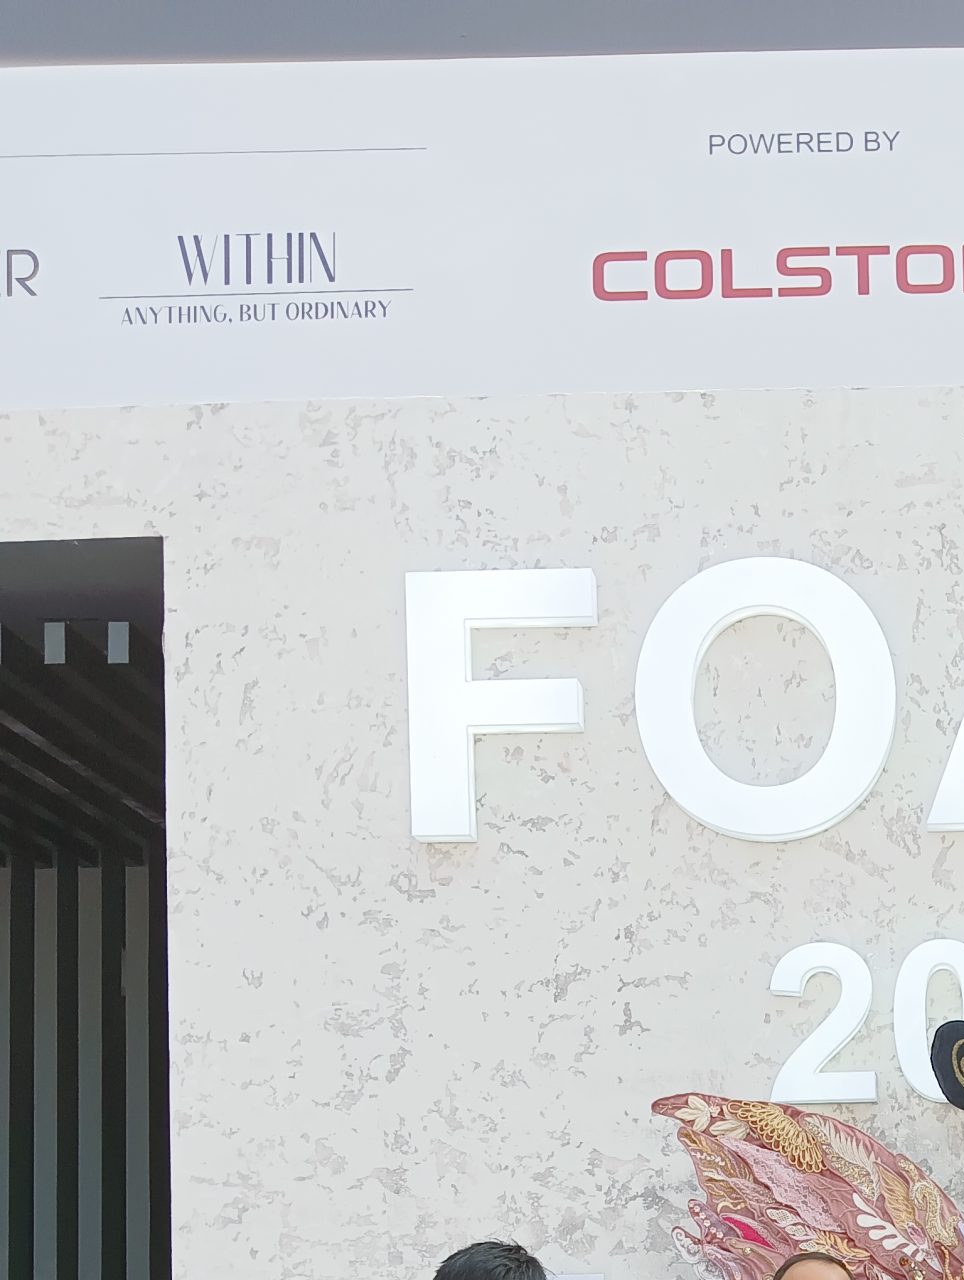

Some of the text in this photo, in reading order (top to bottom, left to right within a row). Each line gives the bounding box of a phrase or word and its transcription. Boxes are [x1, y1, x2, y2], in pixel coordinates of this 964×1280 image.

[708, 130, 901, 156] POWERED BY
[176, 231, 336, 287] WITHIN
[120, 299, 392, 326] ANYTHING, BUT ORDINARY
